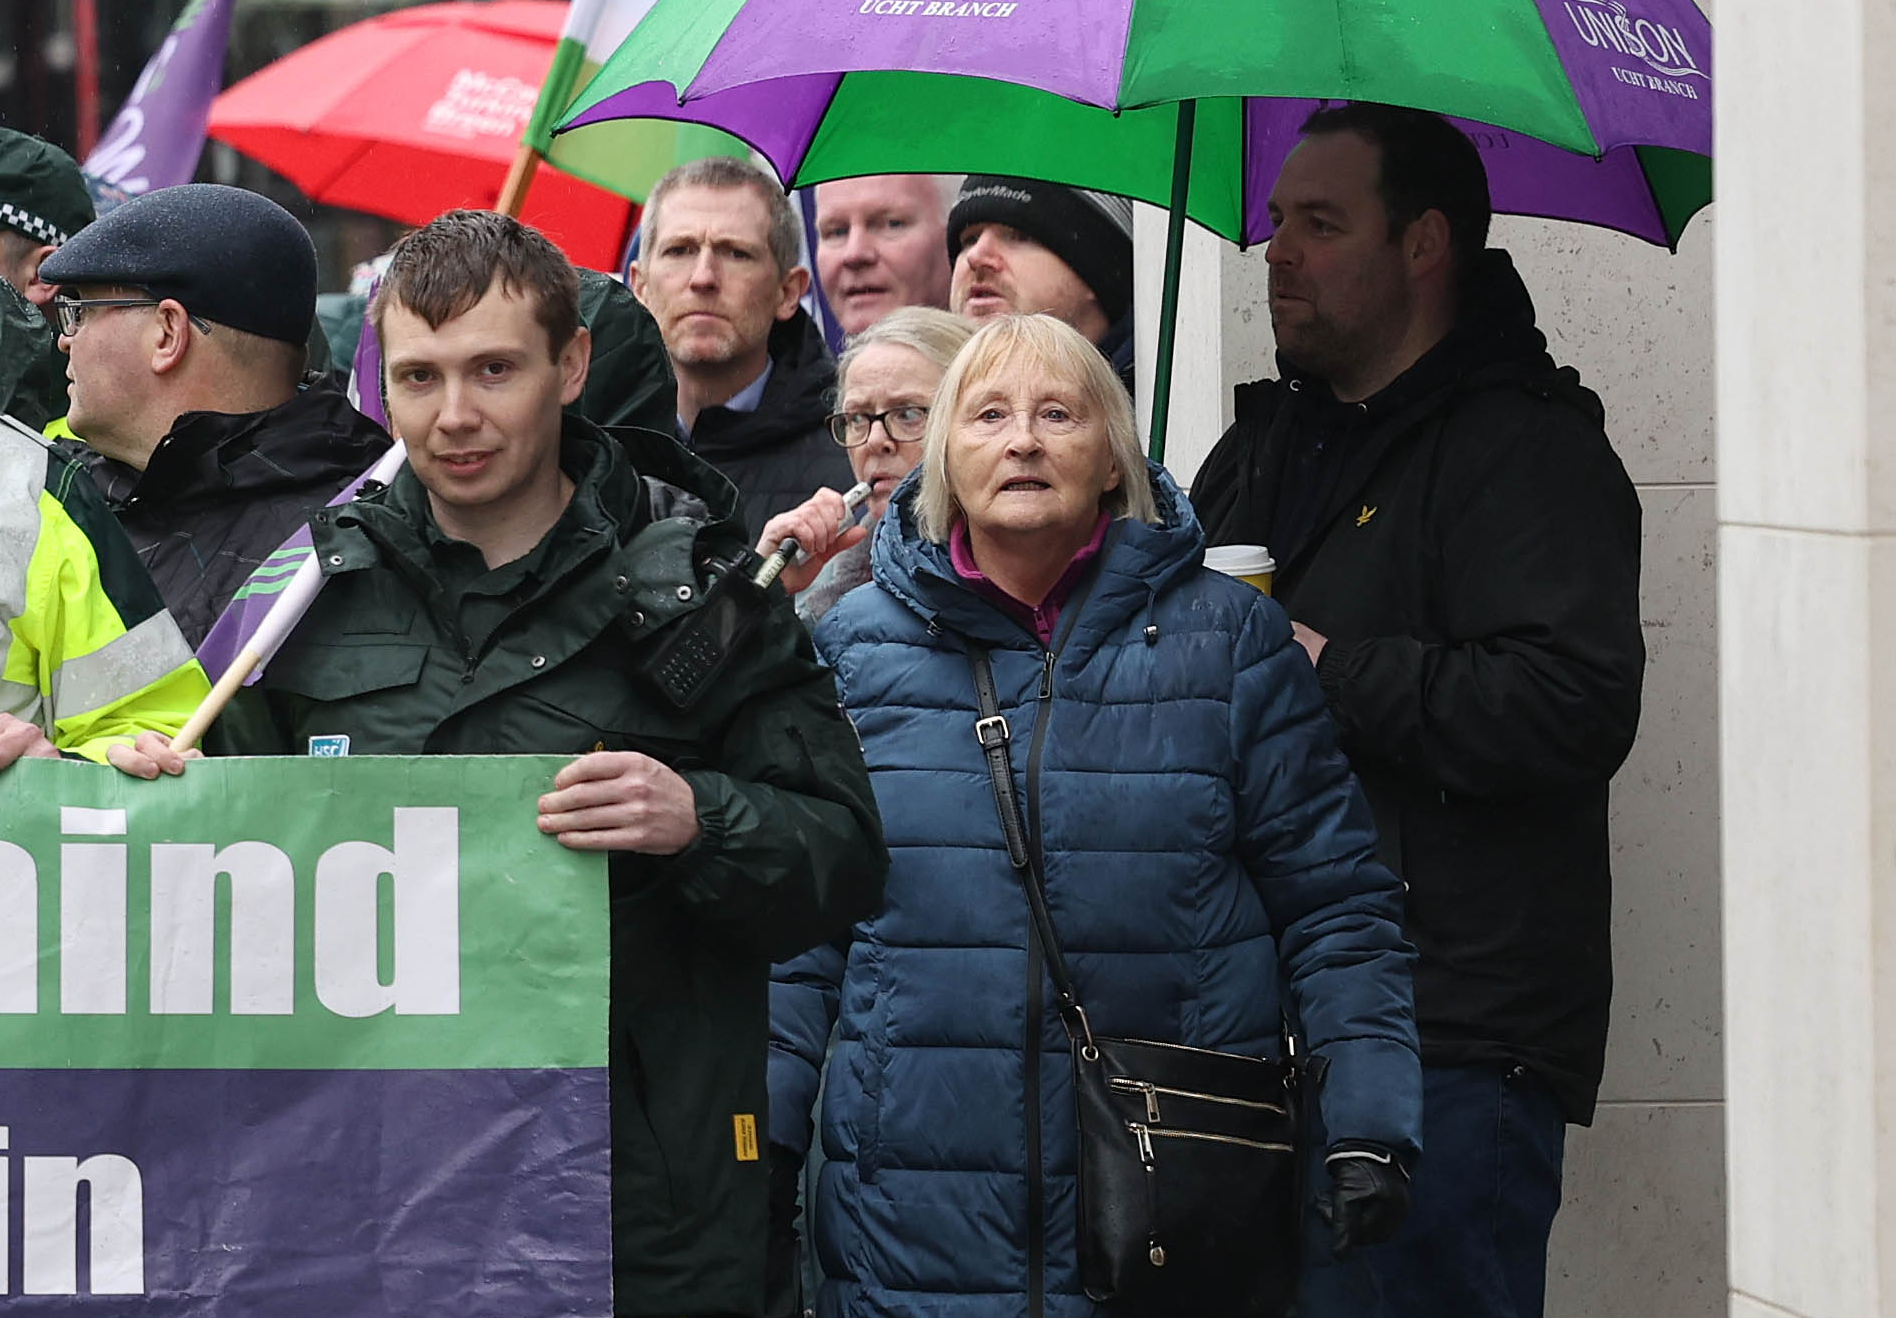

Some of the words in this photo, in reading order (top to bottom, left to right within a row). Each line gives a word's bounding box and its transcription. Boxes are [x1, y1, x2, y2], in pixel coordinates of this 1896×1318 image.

[859, 0, 924, 15] UCHT
[921, 1, 1018, 18] BRANCH
[1563, 1, 1697, 69] UNISON
[1610, 66, 1645, 90] UCHT
[1646, 74, 1698, 100] BRANCH
